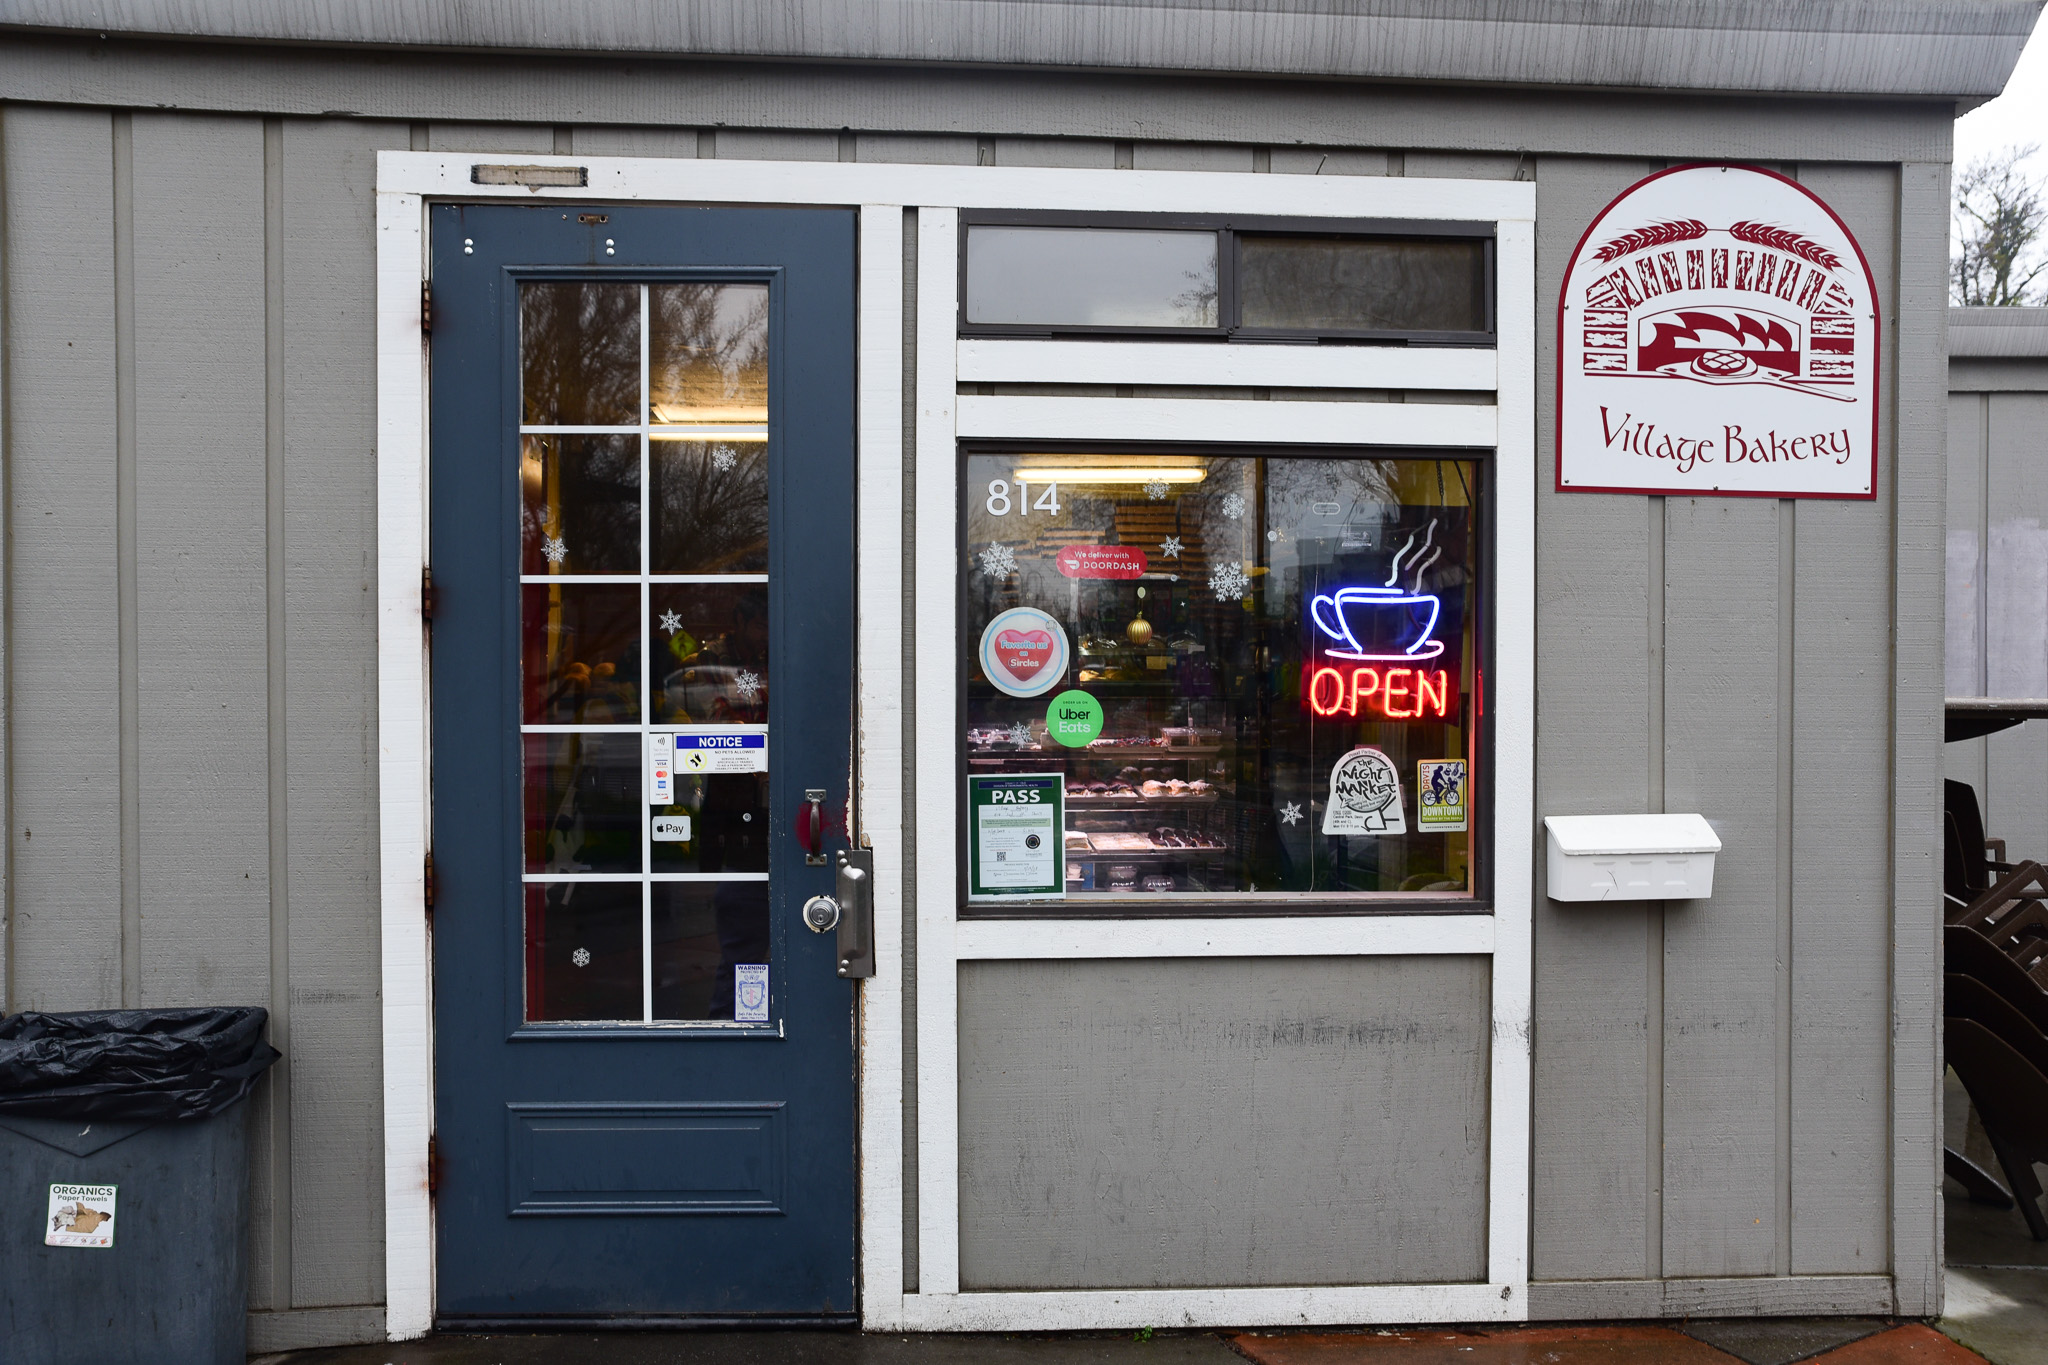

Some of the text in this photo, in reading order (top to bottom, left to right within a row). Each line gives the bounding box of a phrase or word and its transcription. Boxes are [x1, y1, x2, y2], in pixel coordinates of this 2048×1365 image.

[1600, 406, 1850, 473] Village Bakery
[986, 479, 1060, 516] 814
[1083, 561, 1139, 570] DOORDASH
[1001, 640, 1048, 649] Favorite us
[1010, 659, 1039, 668] Sircles
[1310, 667, 1447, 717] OPEN
[1059, 709, 1090, 720] Uber
[1059, 721, 1091, 733] Eats
[699, 737, 742, 747] NOTICE
[992, 790, 1040, 803] PASS
[1423, 806, 1462, 816] DOWNTOWN
[666, 824, 684, 835] Pay
[53, 1186, 113, 1196] ORGANICS
